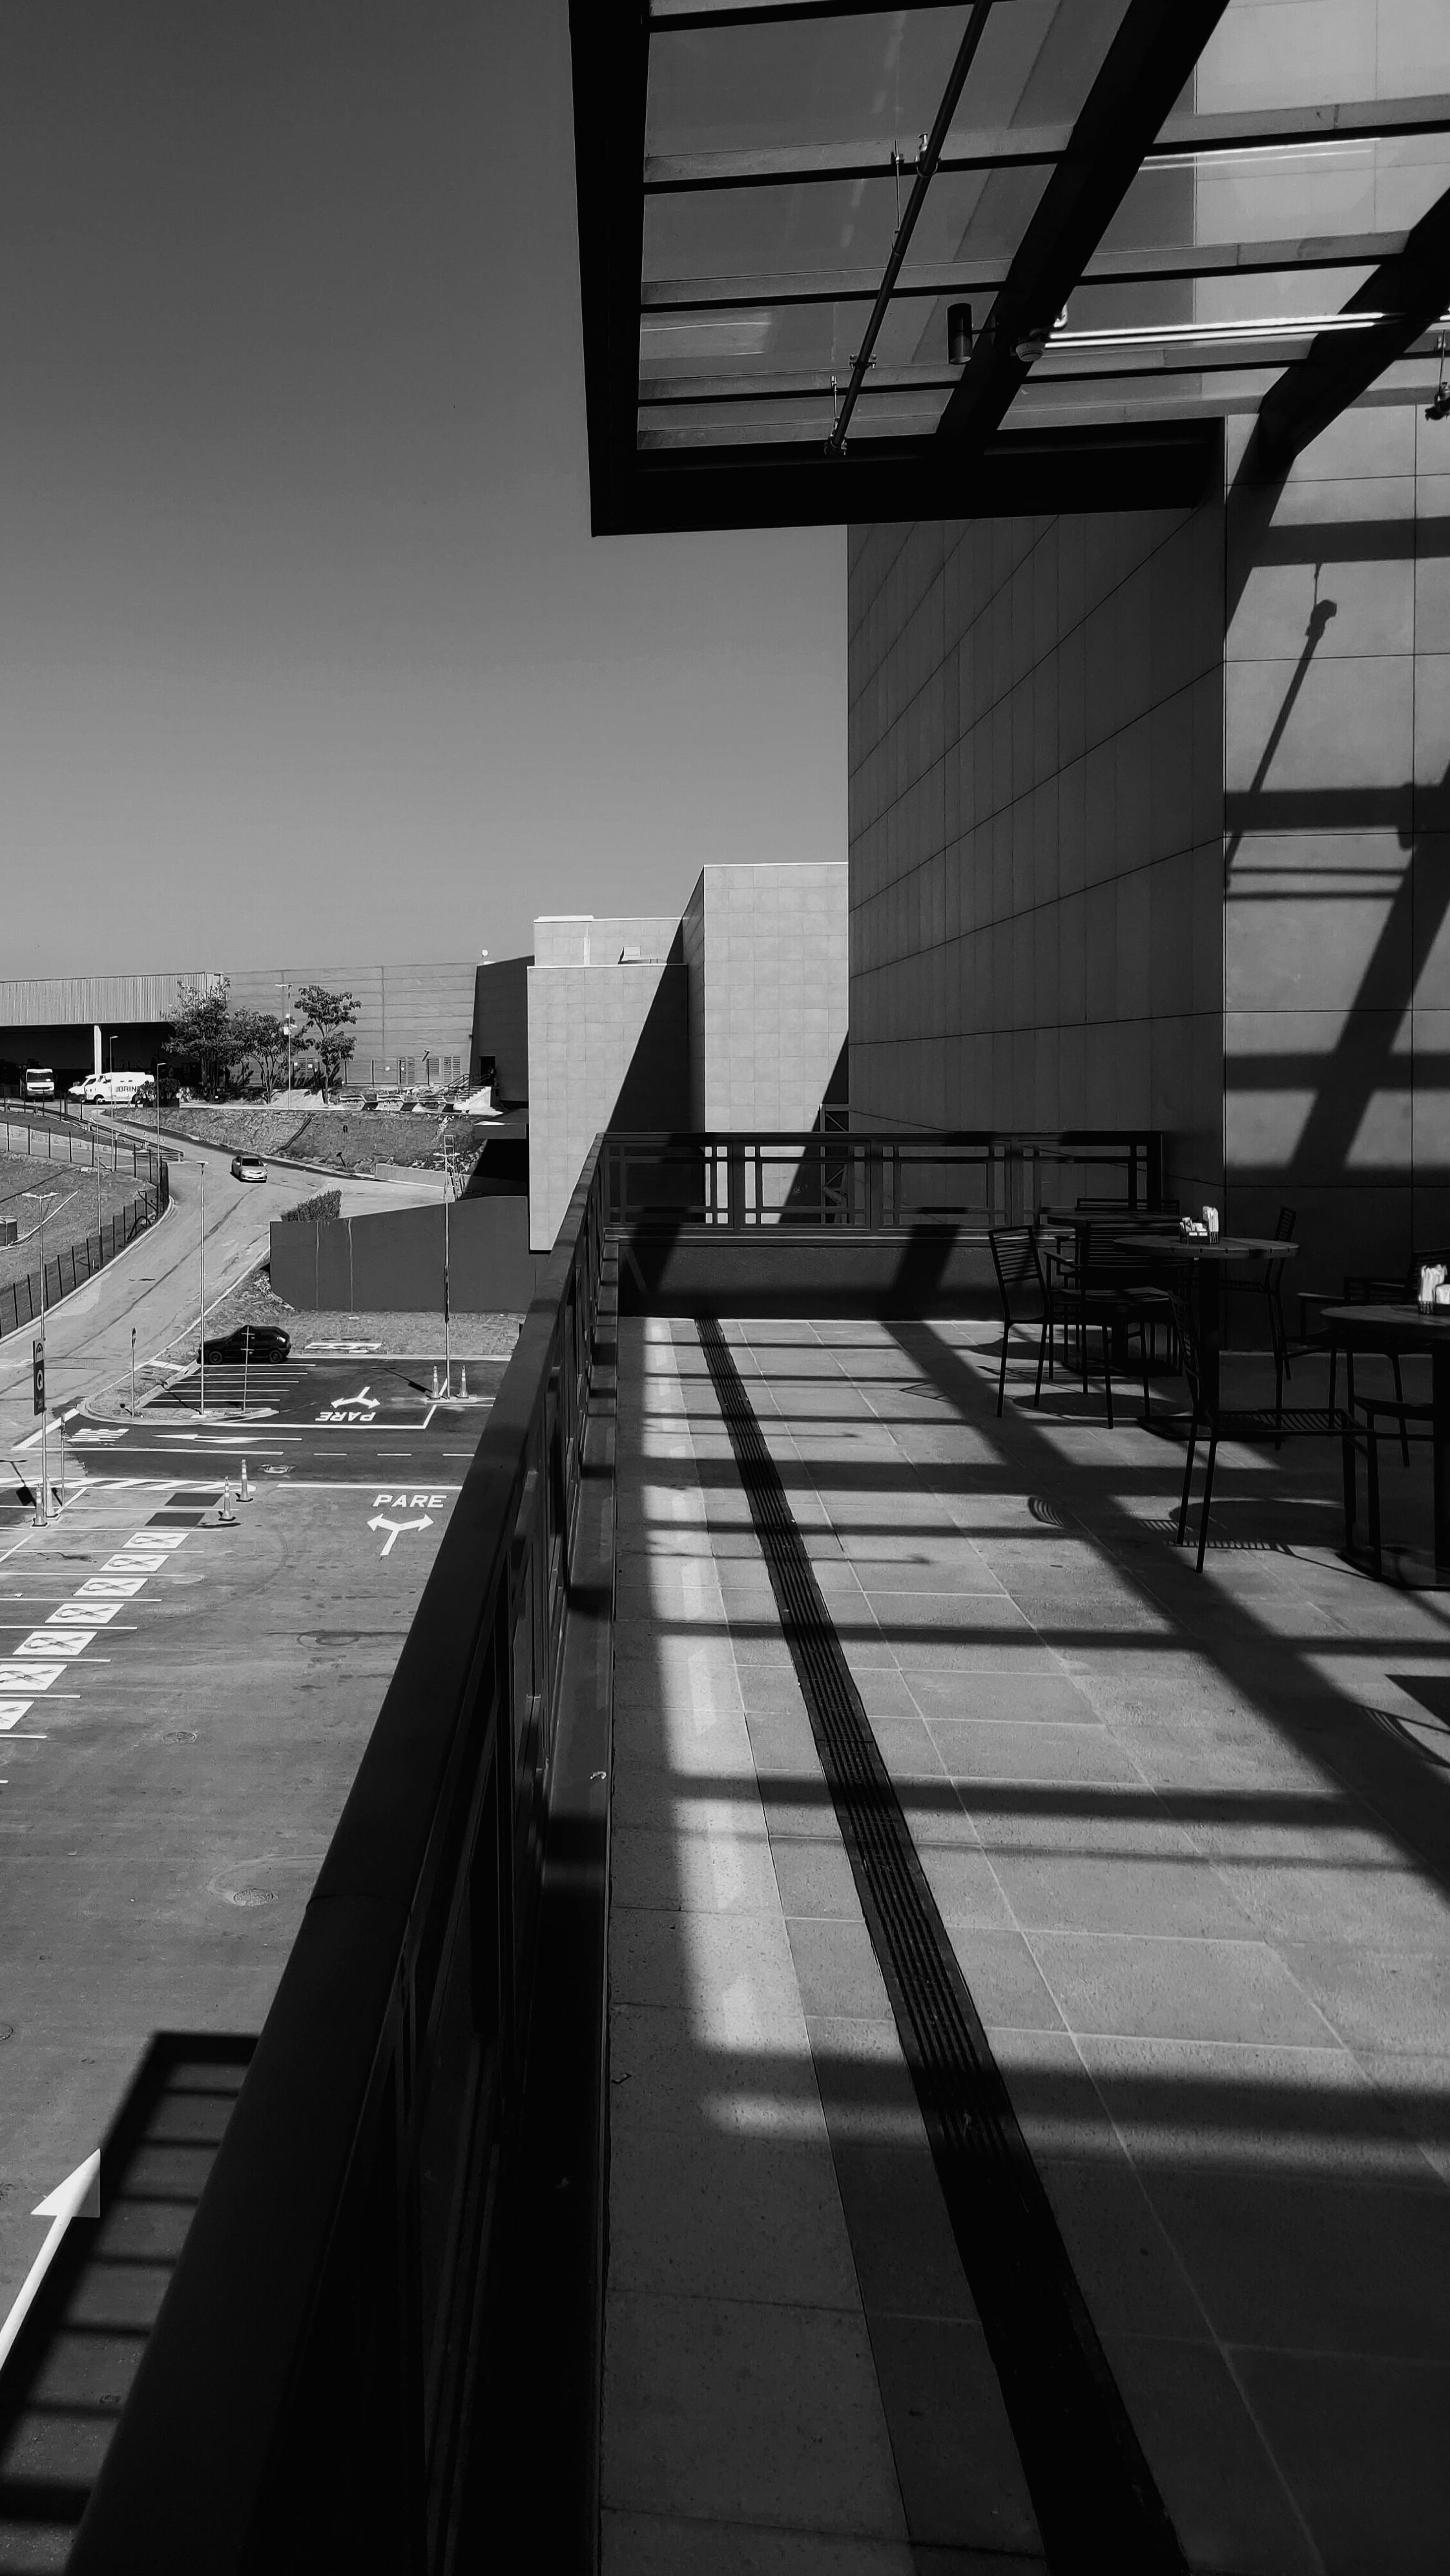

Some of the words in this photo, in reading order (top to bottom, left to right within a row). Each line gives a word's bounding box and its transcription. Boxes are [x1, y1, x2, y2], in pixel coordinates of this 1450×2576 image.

[37, 1370, 43, 1390] Q
[315, 1412, 377, 1421] PARE
[66, 1428, 129, 1442] PARE
[372, 1494, 447, 1508] PARE
